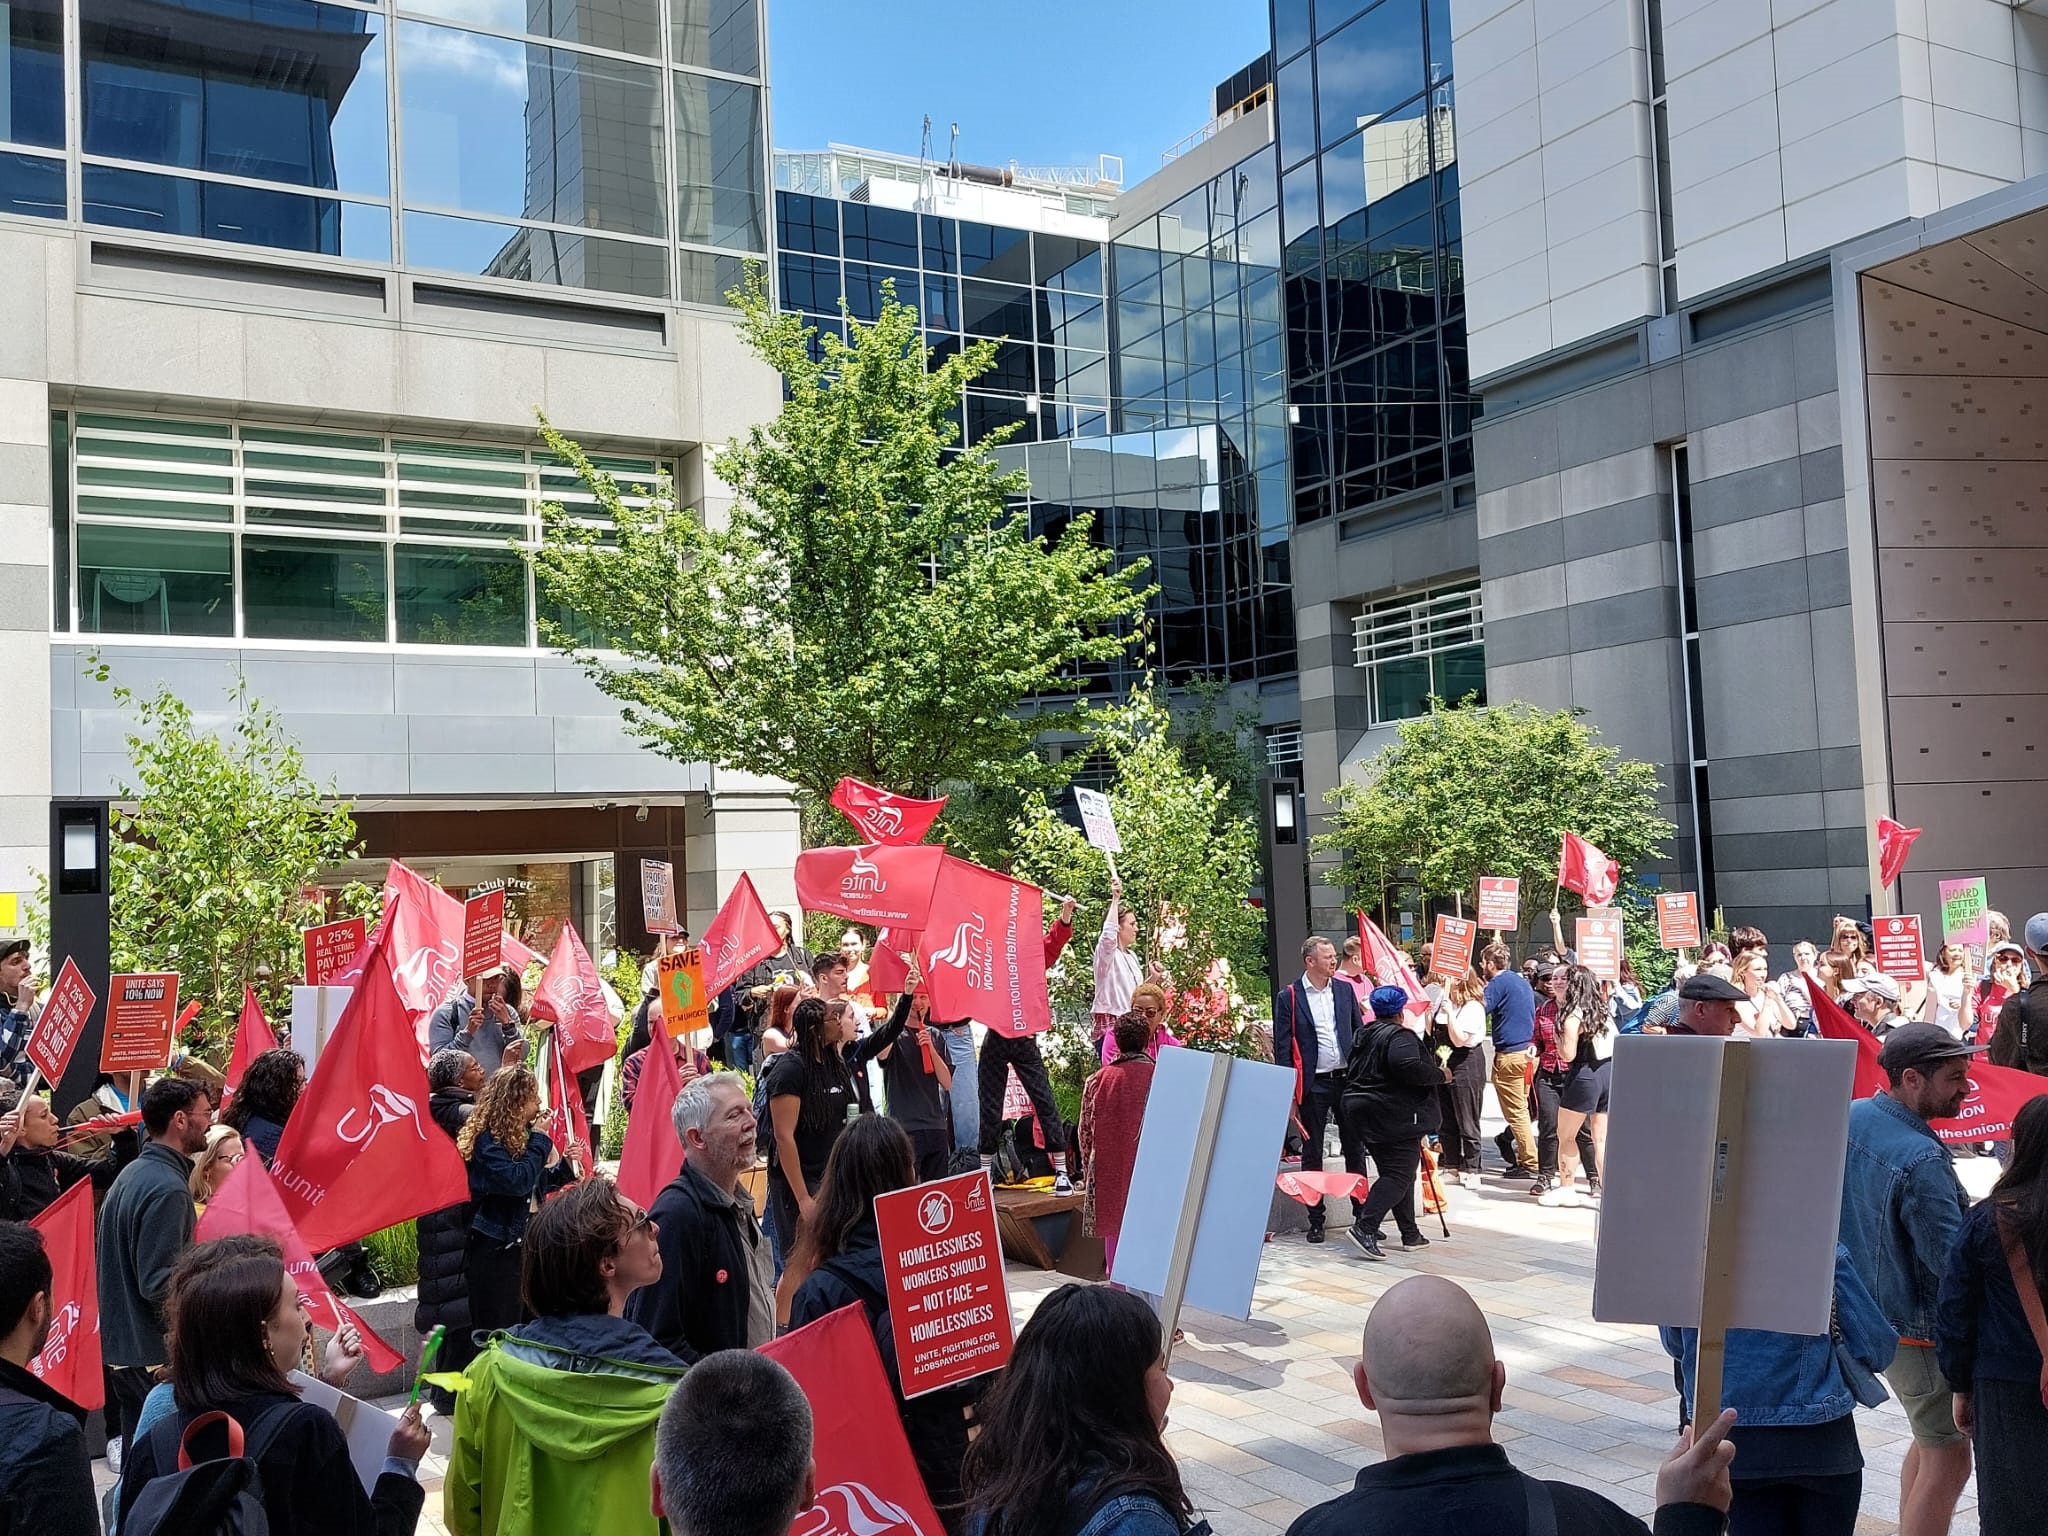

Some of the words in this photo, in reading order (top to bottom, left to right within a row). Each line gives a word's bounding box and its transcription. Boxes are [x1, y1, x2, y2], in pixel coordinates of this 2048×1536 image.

[477, 877, 505, 892] Club
[507, 877, 533, 890] Pret
[1945, 888, 1979, 900] BOARD
[1946, 899, 1980, 909] BETTER
[1947, 908, 1968, 919] HAVE
[1969, 908, 1980, 918] MY
[1949, 919, 1980, 931] MONEY
[316, 935, 323, 947] A
[328, 928, 354, 944] 25%
[316, 947, 332, 958] REAL
[334, 942, 355, 953] TERMS
[317, 957, 334, 971] PAY
[338, 951, 355, 966] CUT
[660, 950, 700, 972] SAVE
[126, 979, 146, 989] UNITE
[147, 979, 165, 988] SAYS
[318, 971, 329, 985] IS
[64, 976, 72, 991] A
[69, 984, 86, 1012] 25%
[124, 989, 143, 1000] 10%
[144, 988, 164, 999] NOW
[50, 1003, 65, 1026] PAY
[61, 1018, 74, 1040] CUT
[41, 1019, 53, 1040] IS
[50, 1030, 67, 1058] NOT
[964, 1195, 986, 1210] unite
[899, 1230, 983, 1269] HOMELESSNESS
[902, 1265, 949, 1292] WORKERS
[950, 1255, 987, 1279] SHOULD
[923, 1290, 944, 1313] NOT
[947, 1282, 974, 1306] FACE
[910, 1304, 994, 1344] HOMELESSNESS
[914, 1348, 942, 1363] UNITE,
[942, 1336, 979, 1355] FIGHTING
[979, 1331, 996, 1345] FOR
[913, 1341, 1000, 1375] #JOBSPAYCONDITIONS
